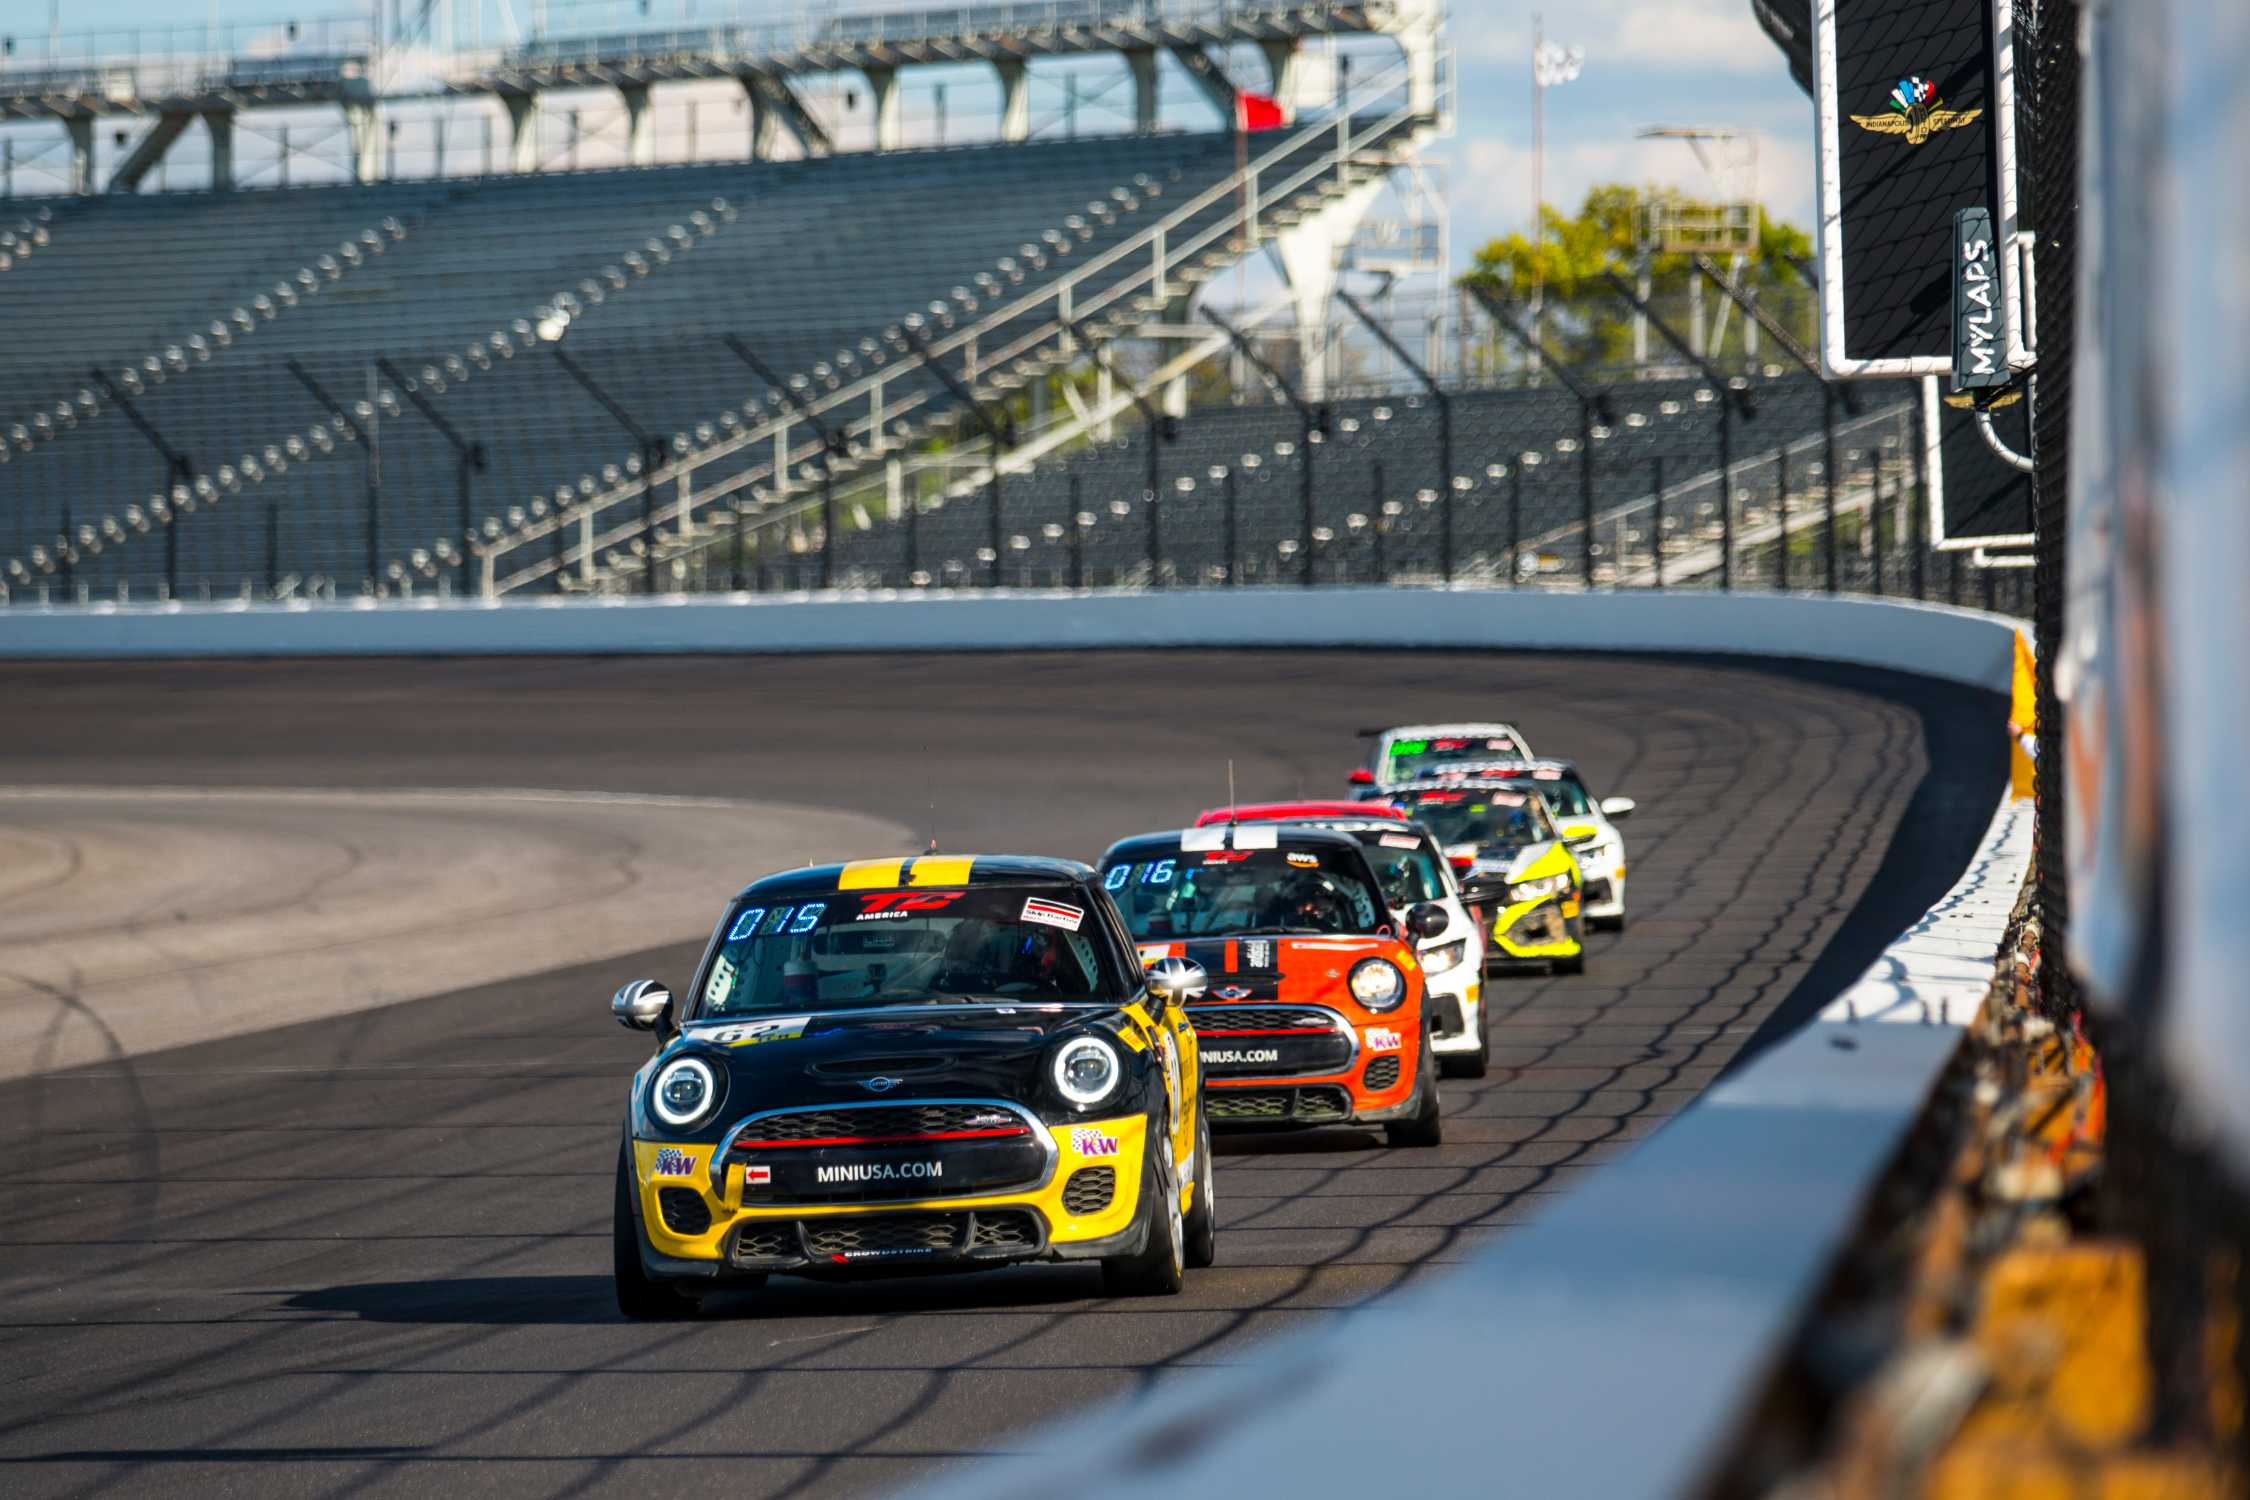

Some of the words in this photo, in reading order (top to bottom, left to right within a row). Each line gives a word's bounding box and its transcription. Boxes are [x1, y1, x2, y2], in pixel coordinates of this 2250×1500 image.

[1964, 239, 1996, 375] MYLAPS
[861, 891, 966, 912] TC
[729, 902, 826, 940] 015
[856, 910, 908, 921] AMERICA
[1081, 1137, 1118, 1155] KW
[660, 1157, 697, 1175] KW
[817, 1161, 943, 1182] MINIUSA.COM
